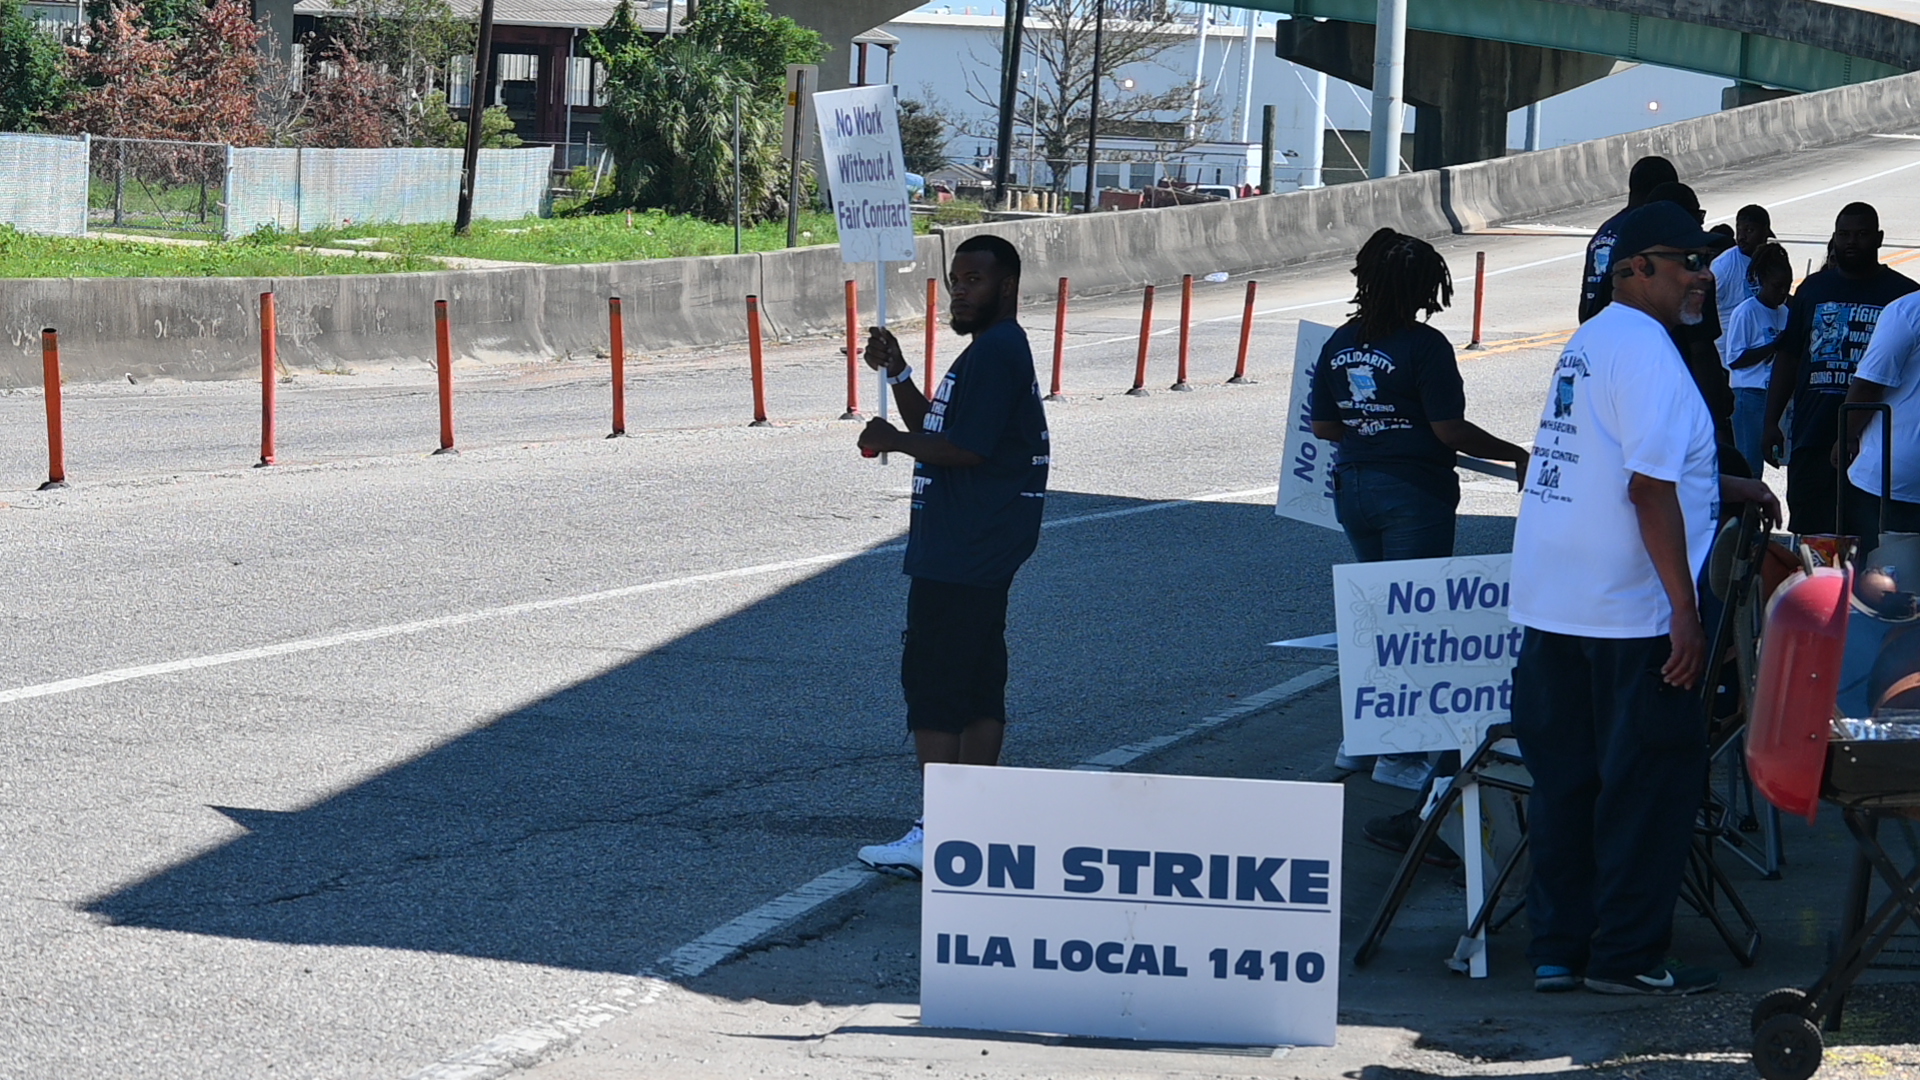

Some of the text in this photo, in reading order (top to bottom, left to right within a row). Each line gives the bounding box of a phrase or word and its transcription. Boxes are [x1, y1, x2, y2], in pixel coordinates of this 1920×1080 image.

[835, 104, 884, 138] No Work
[837, 150, 895, 184] Without A
[838, 199, 908, 230] Fair Contract
[1849, 306, 1882, 323] FIGH
[1330, 351, 1397, 375] SOLIDARITY
[1834, 371, 1846, 385] TO
[1293, 441, 1318, 484] No
[1387, 576, 1510, 615] No Wor
[1376, 626, 1522, 667] Without
[1354, 678, 1514, 720] Fair Cont
[933, 840, 1330, 905] ON STRIKE
[936, 932, 1326, 983] ILA LOCAL 1410
